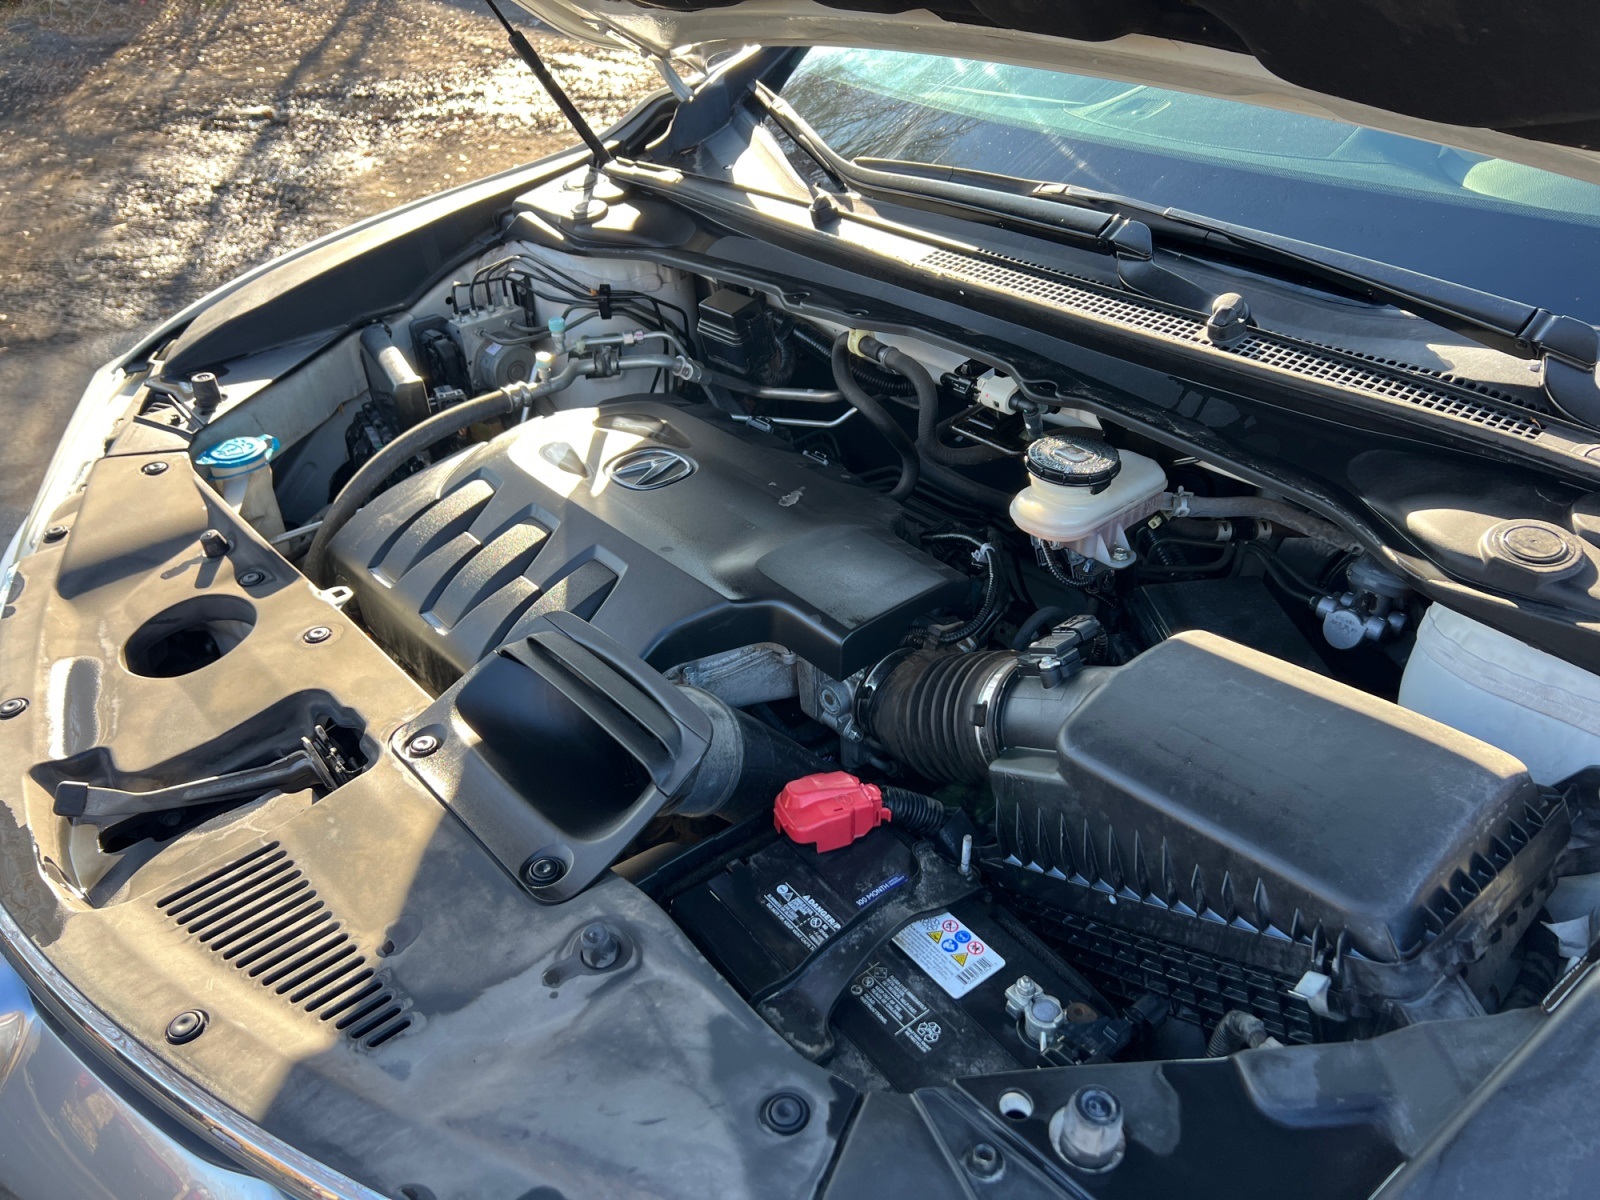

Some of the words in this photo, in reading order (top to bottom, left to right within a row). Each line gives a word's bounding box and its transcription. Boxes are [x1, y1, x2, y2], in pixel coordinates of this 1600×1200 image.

[856, 897, 868, 906] 100
[866, 882, 890, 900] MONTH
[784, 920, 794, 929] KEEP
